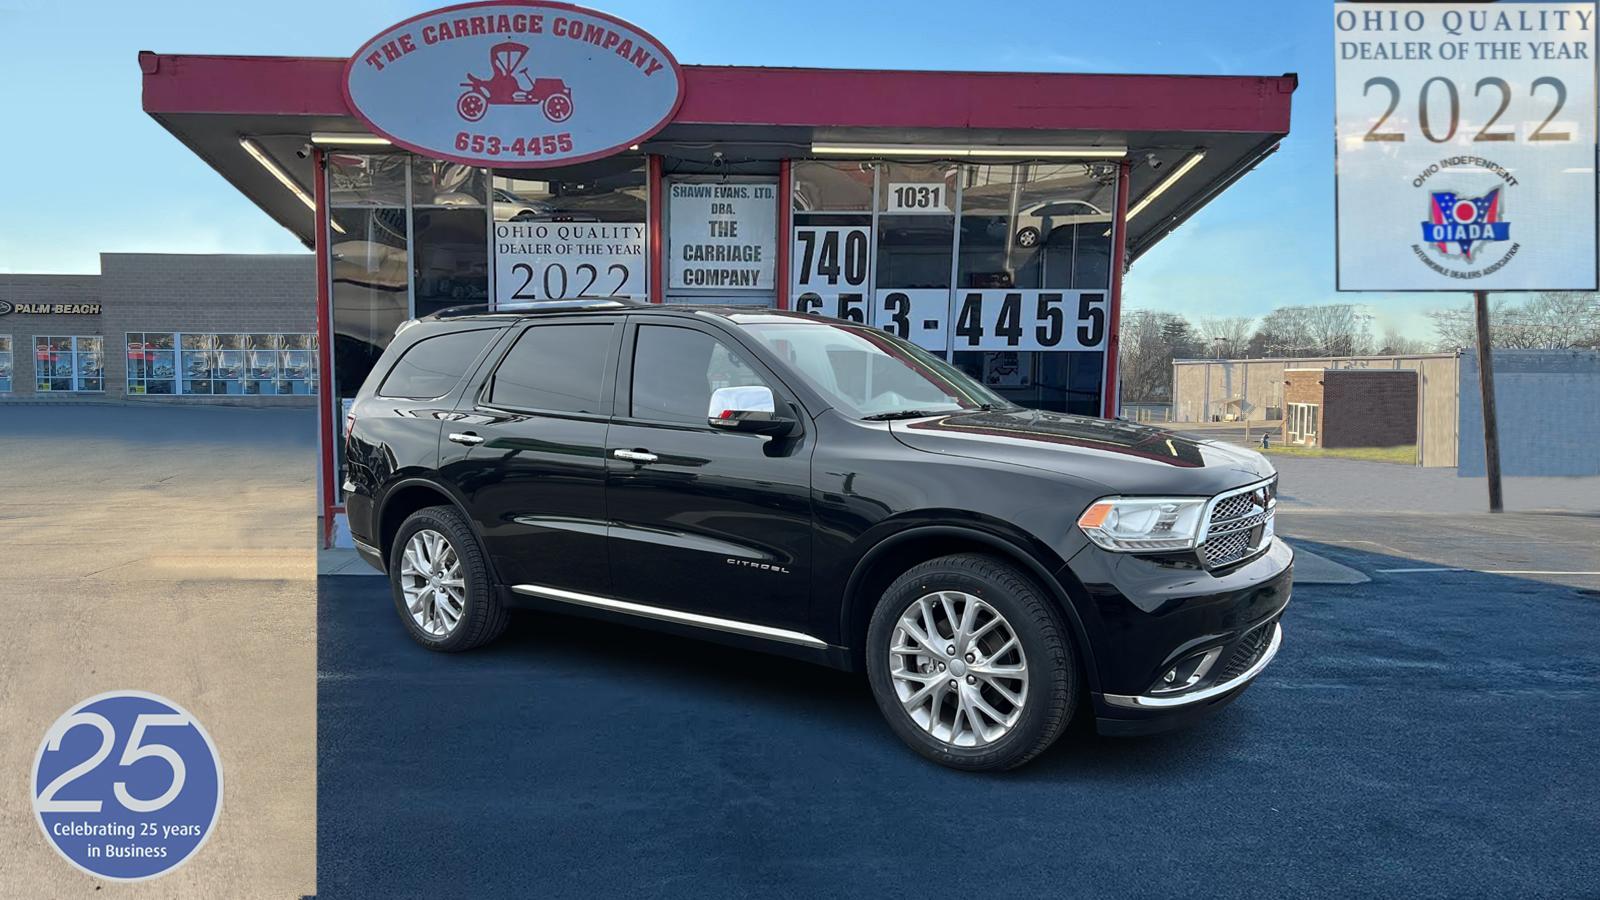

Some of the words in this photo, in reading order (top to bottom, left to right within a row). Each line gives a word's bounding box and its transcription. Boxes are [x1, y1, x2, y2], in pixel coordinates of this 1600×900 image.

[1336, 10, 1425, 31] OHIO
[1442, 10, 1592, 35] QUALITY
[366, 33, 417, 71] THE
[422, 14, 544, 46] CARRIAGE
[552, 17, 664, 77] COMPANY
[1340, 42, 1433, 60] DEALER
[1438, 42, 1469, 60] OF
[1475, 42, 1521, 60] THE
[1528, 42, 1589, 60] YEAR
[1363, 76, 1570, 143] 2022
[454, 132, 573, 156] 653-4455
[1413, 164, 1439, 188] OHIO
[1440, 156, 1519, 187] INDEPENDENT
[672, 186, 712, 198] SHAWN
[754, 187, 774, 199] LTD.
[895, 187, 940, 208] 1031
[711, 203, 736, 215] DBA.
[497, 226, 548, 239] OHIO
[558, 226, 644, 241] QUALITY
[708, 221, 737, 238] THE
[1433, 224, 1495, 240] OIADA
[500, 243, 551, 255] DEALER
[555, 243, 573, 255] OF
[576, 243, 603, 255] THE
[605, 244, 641, 255] YEAR
[683, 245, 762, 262] CARRIAGE
[797, 230, 868, 286] 740
[1450, 270, 1482, 280] DEALERS
[1483, 242, 1520, 276] ASSOCIATION
[511, 263, 631, 300] 2022
[683, 268, 760, 286] COMPANY
[14, 304, 51, 314] PALM
[55, 304, 100, 314] BEACH
